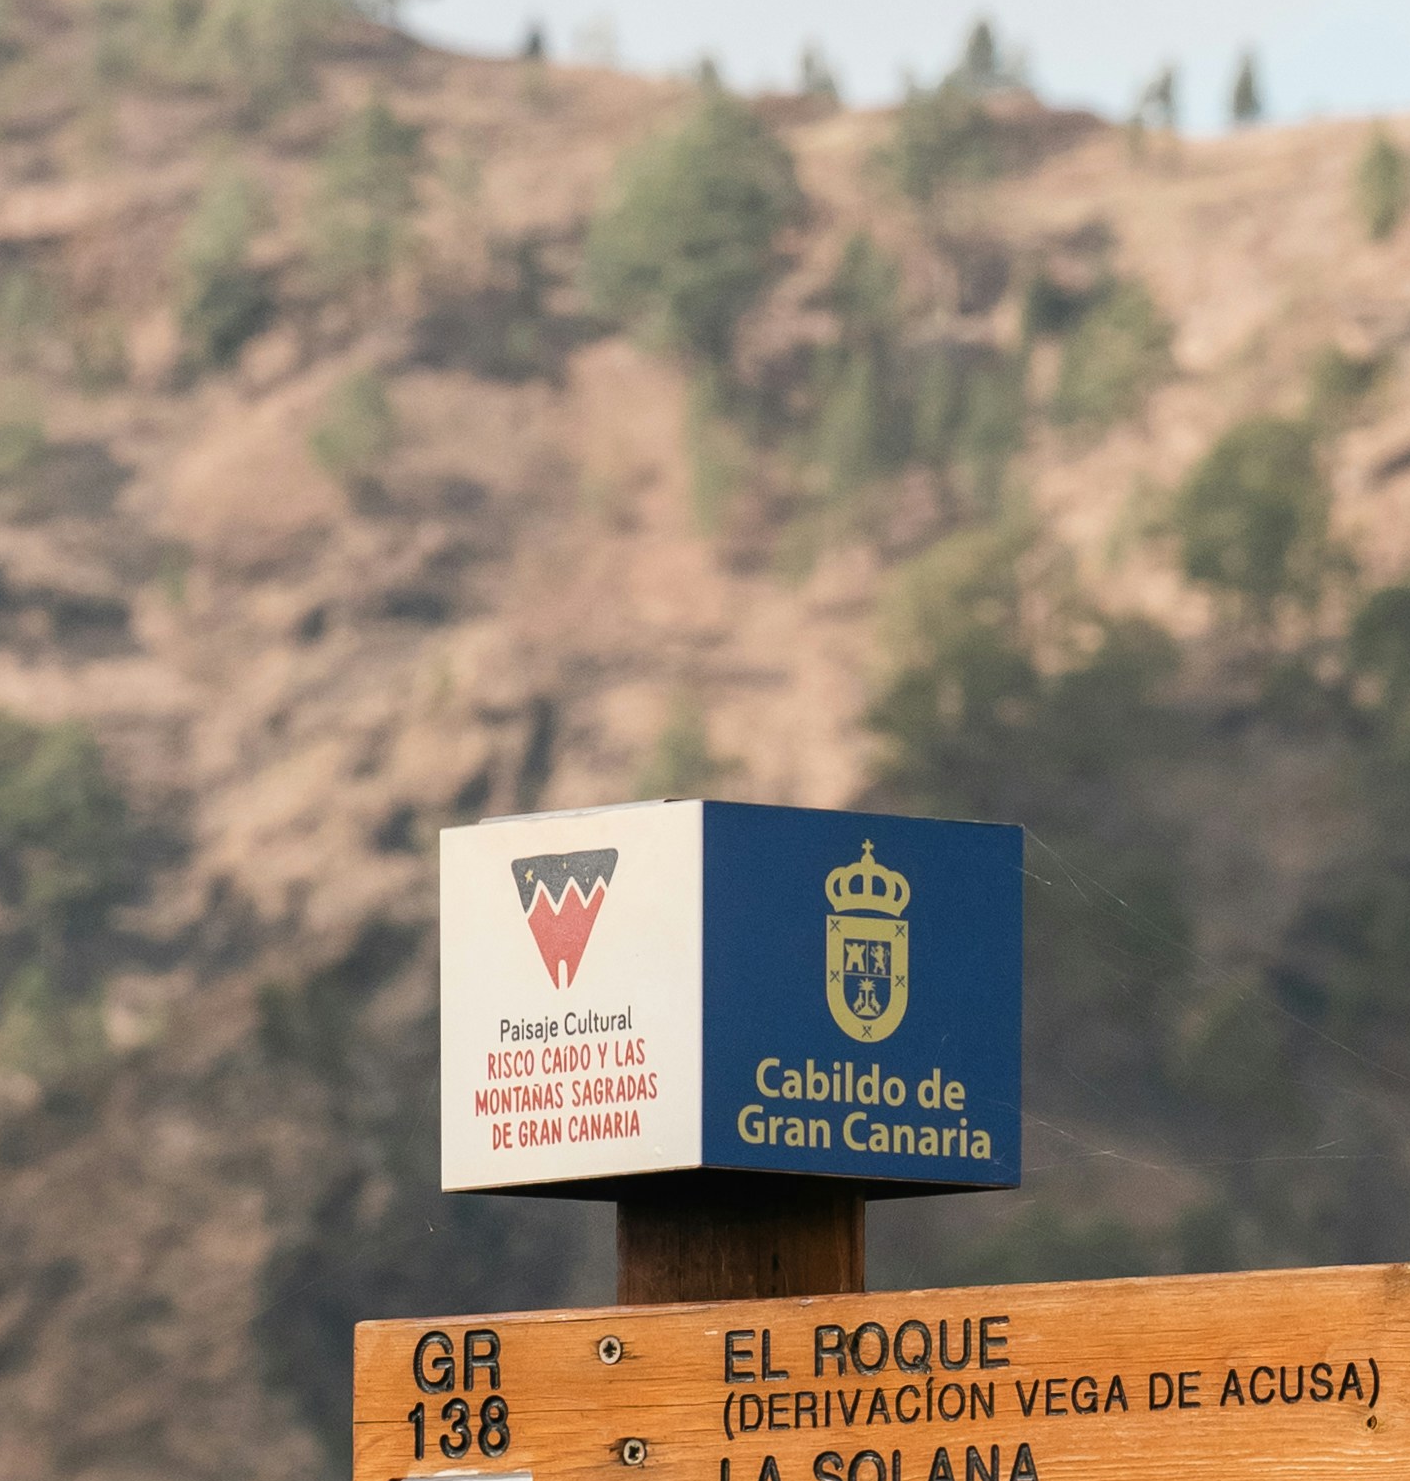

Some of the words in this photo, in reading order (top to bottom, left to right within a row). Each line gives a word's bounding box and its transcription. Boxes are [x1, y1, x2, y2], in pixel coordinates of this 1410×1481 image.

[500, 1016, 559, 1043] Paisaje
[564, 1005, 632, 1036] Cultural
[487, 1049, 535, 1080] RISCO
[542, 1044, 590, 1075] CAÍDO
[597, 1041, 608, 1069] Y
[615, 1038, 645, 1067] LAS
[755, 1057, 906, 1107] Cabildo
[917, 1068, 966, 1111] de
[475, 1081, 564, 1117] MONTAÑAS
[572, 1072, 658, 1107] SAGRADAS
[492, 1122, 513, 1151] DE
[518, 1117, 562, 1148] GRAN
[568, 1109, 640, 1143] CANARIA
[737, 1104, 831, 1149] Gran
[842, 1111, 991, 1159] Canaria
[413, 1328, 501, 1394] GR
[724, 1328, 789, 1384] EL
[814, 1315, 1011, 1377] ROQUE
[1015, 1374, 1129, 1417] VEGA
[1149, 1370, 1202, 1411] DE
[1219, 1357, 1380, 1409] ACUSA)
[407, 1395, 511, 1461] 138
